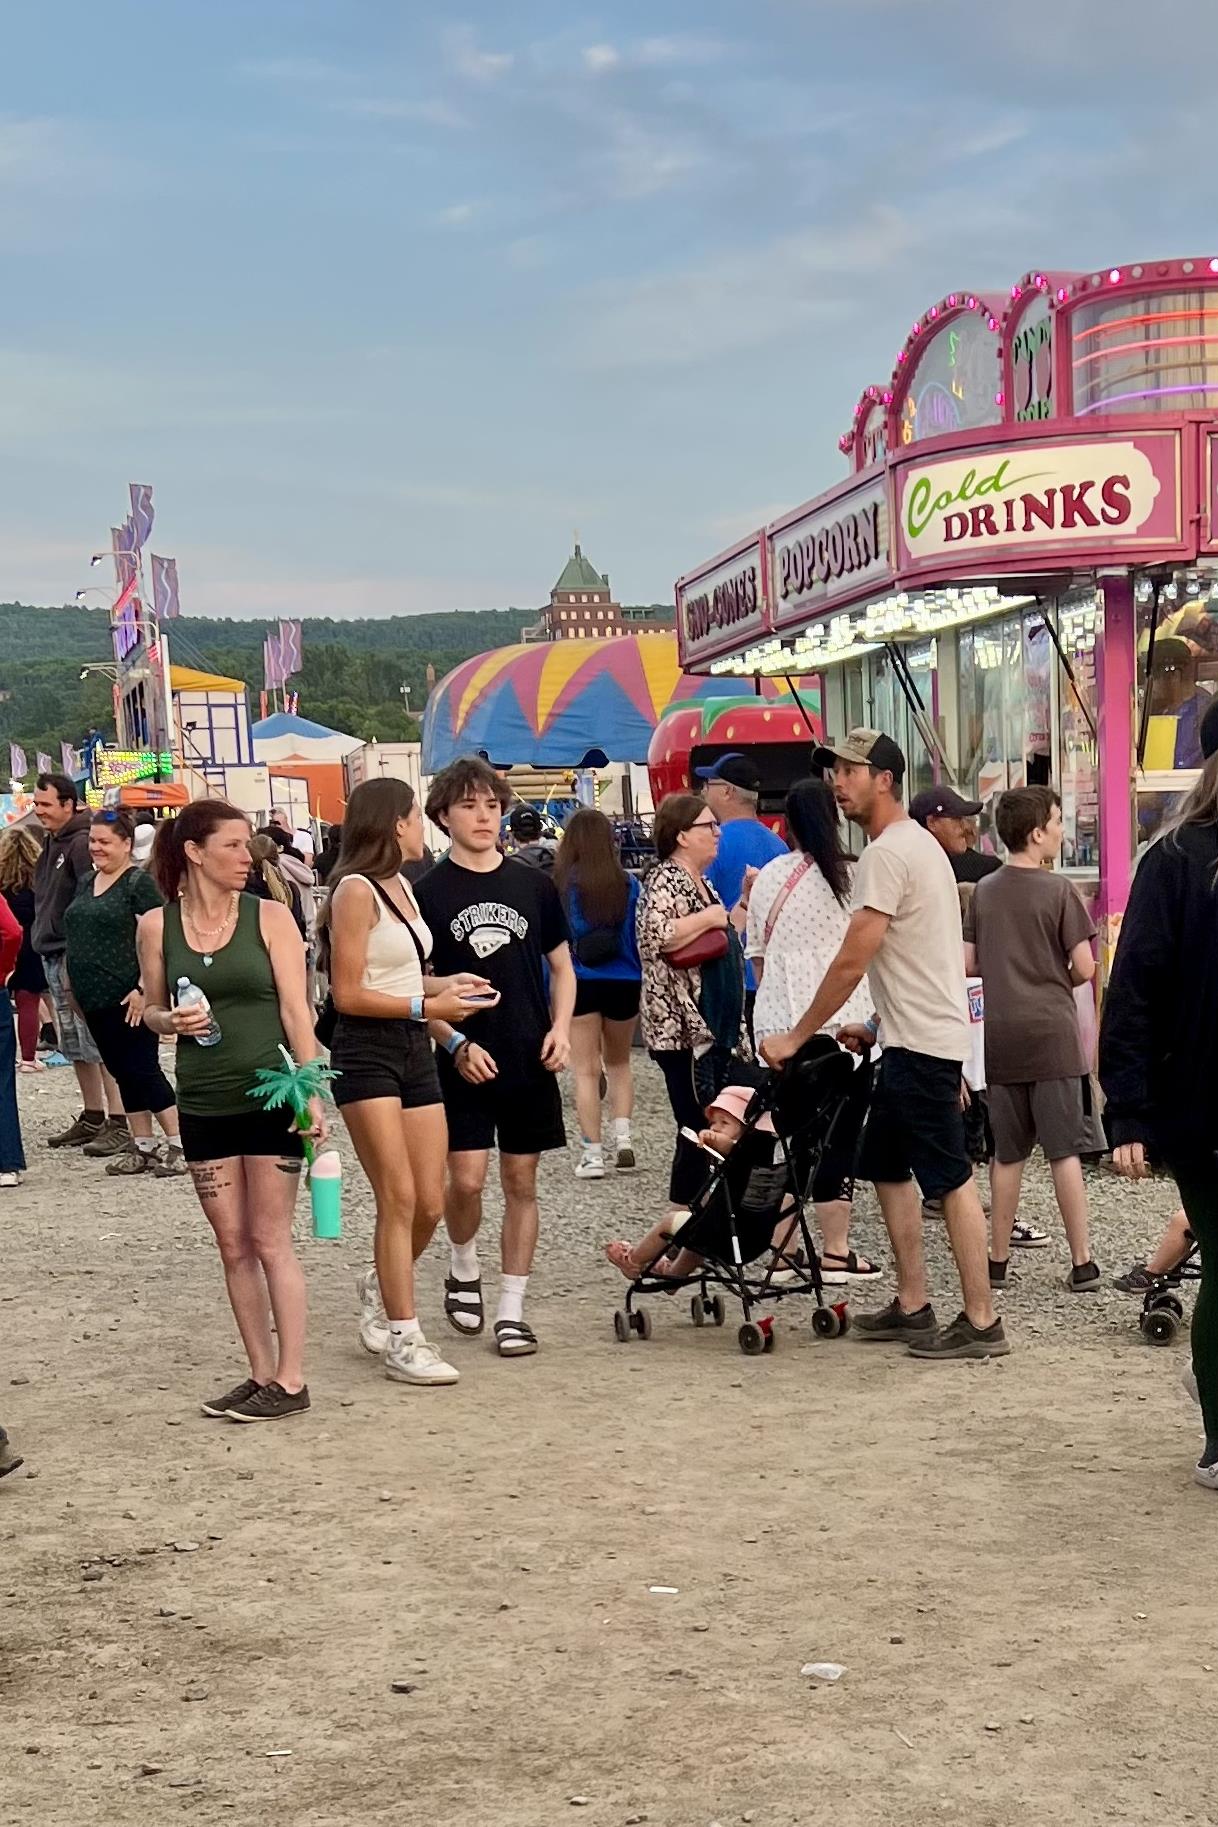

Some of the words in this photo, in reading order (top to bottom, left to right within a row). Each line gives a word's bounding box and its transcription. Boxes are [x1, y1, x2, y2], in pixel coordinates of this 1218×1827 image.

[907, 459, 1057, 539] Cold
[942, 474, 1132, 543] DRINKS
[778, 501, 880, 600] POPCORN
[450, 902, 529, 942] STRIKERS
